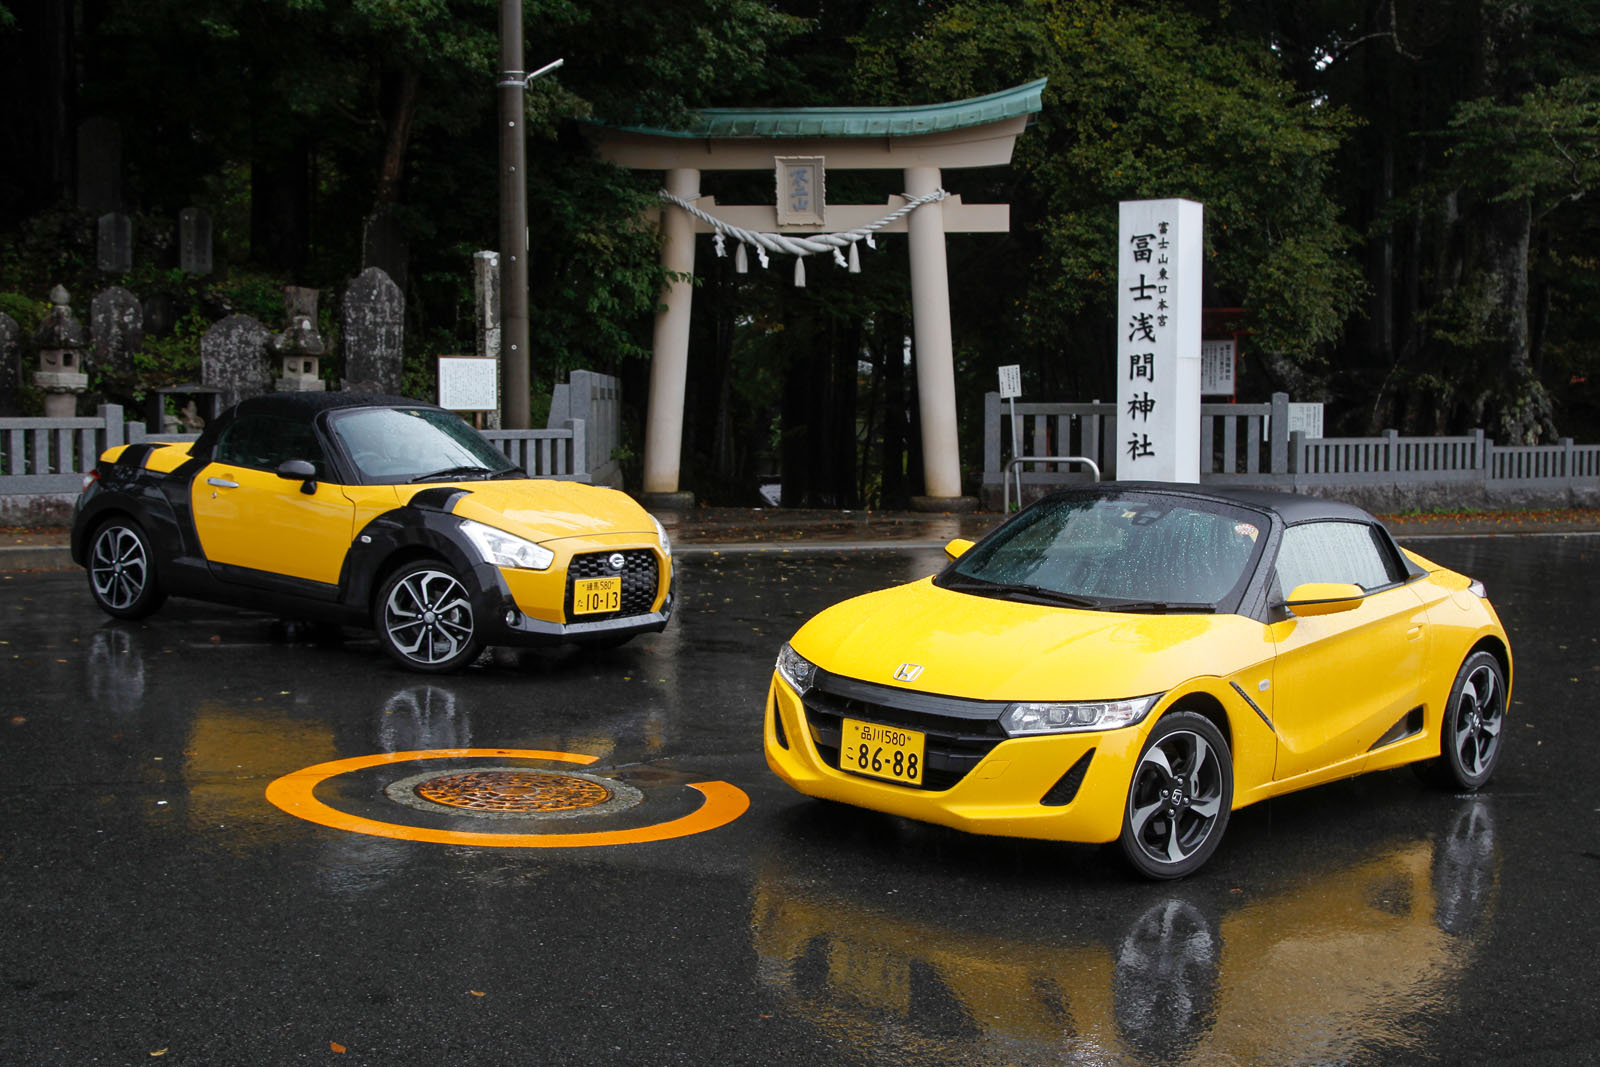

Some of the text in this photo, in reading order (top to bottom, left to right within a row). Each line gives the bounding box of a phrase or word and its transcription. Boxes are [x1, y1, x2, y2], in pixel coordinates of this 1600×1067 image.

[1157, 221, 1169, 327] 富士山東口本宮
[587, 591, 618, 611] 10-13
[858, 743, 918, 779] 86-88
